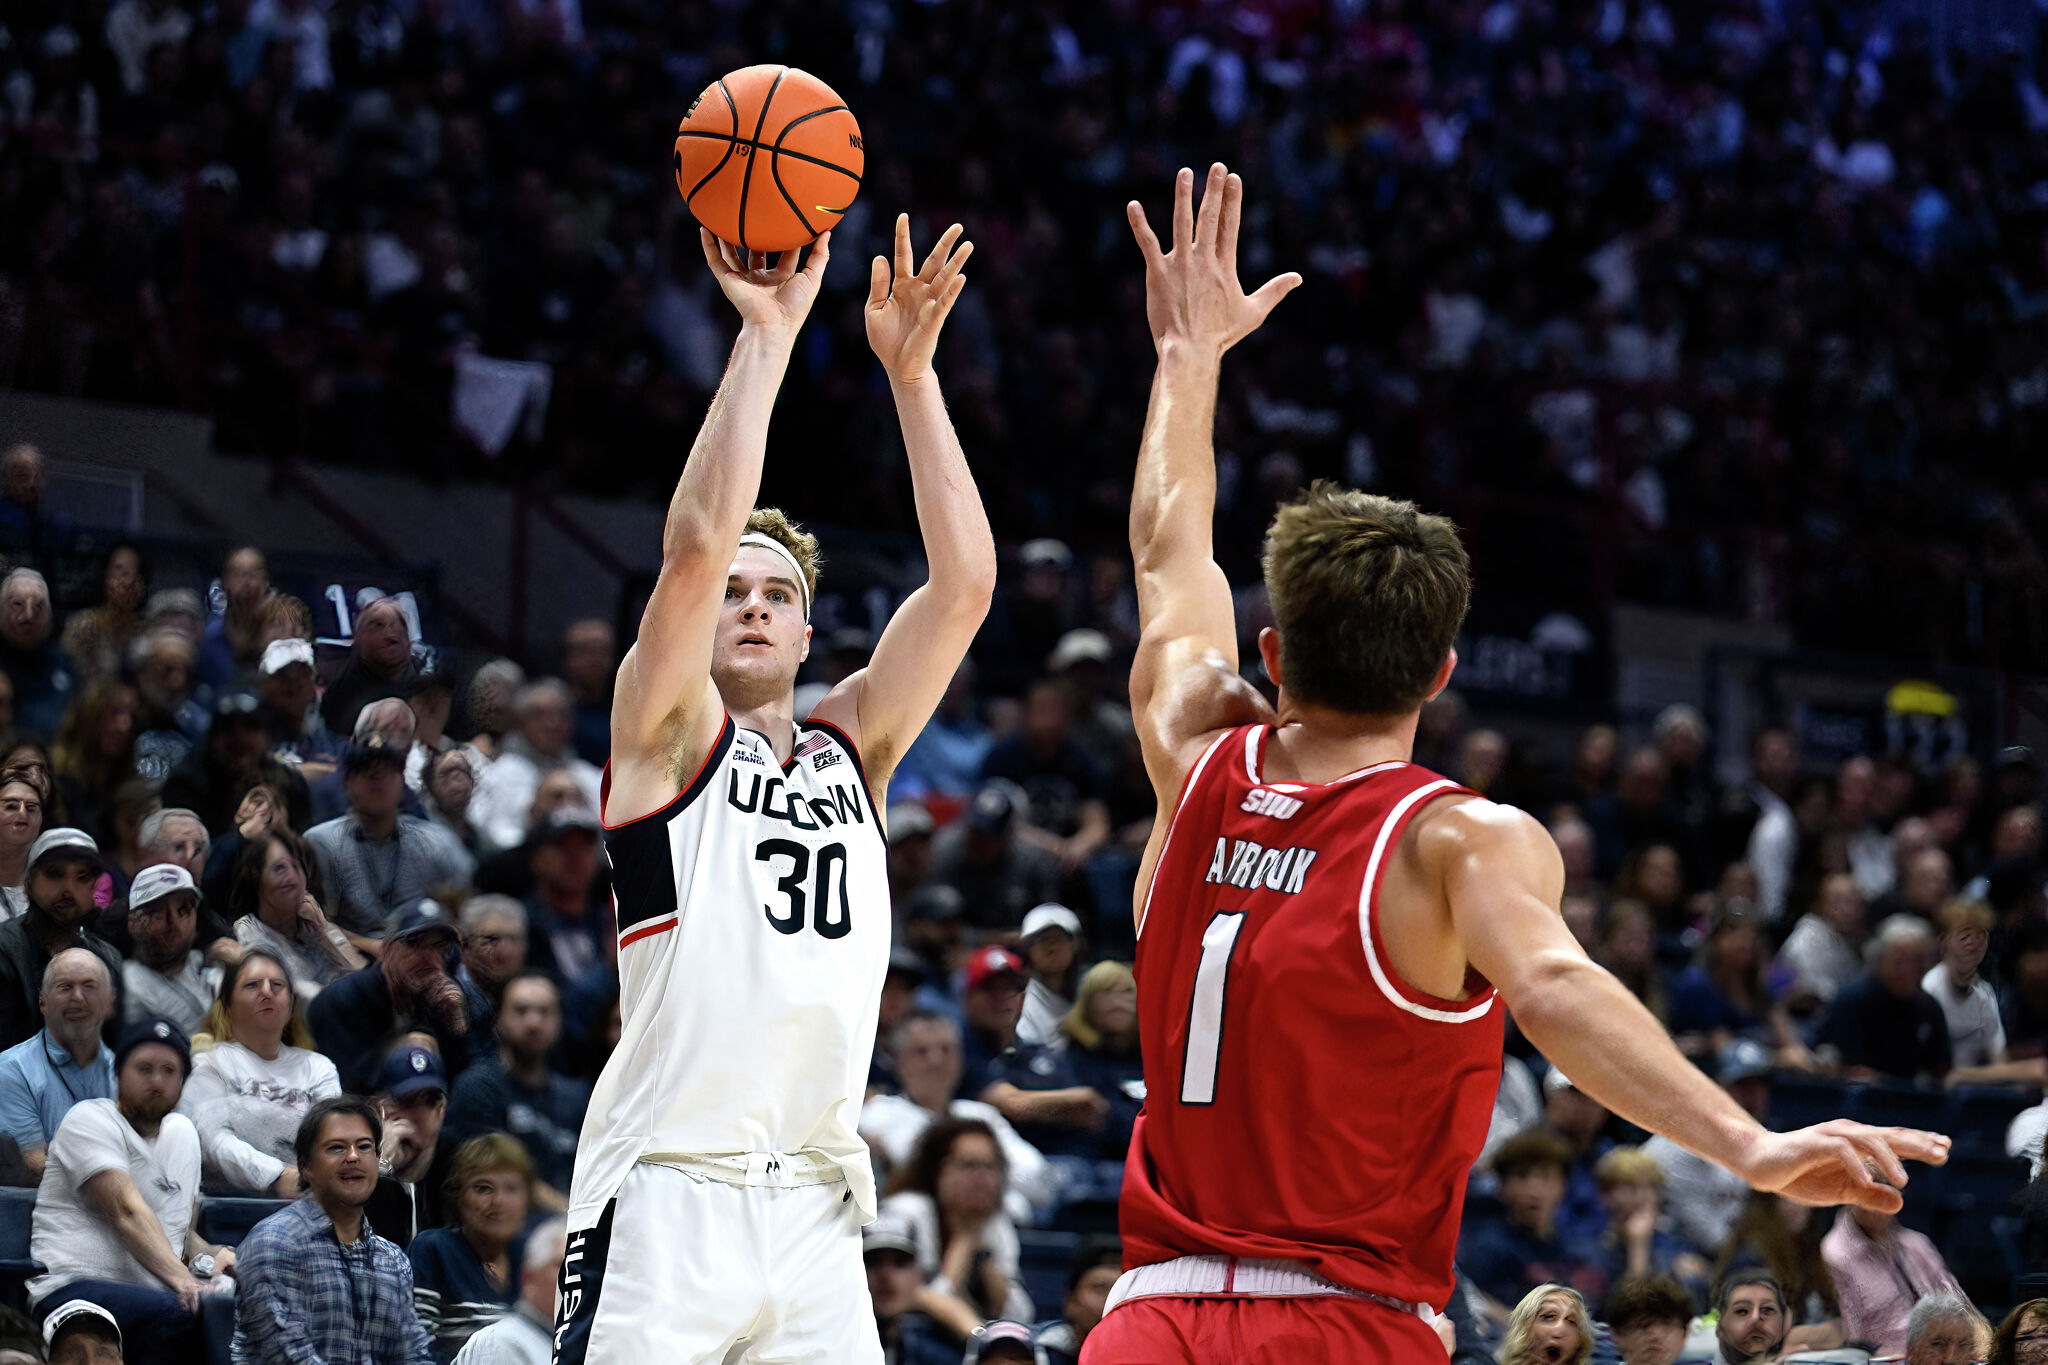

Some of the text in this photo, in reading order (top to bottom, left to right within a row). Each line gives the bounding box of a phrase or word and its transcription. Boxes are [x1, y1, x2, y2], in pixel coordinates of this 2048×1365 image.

[812, 749, 832, 762] BIG
[814, 754, 842, 768] EAST
[728, 767, 864, 830] UCONN
[755, 838, 852, 940] 30
[1179, 909, 1248, 1105] 1
